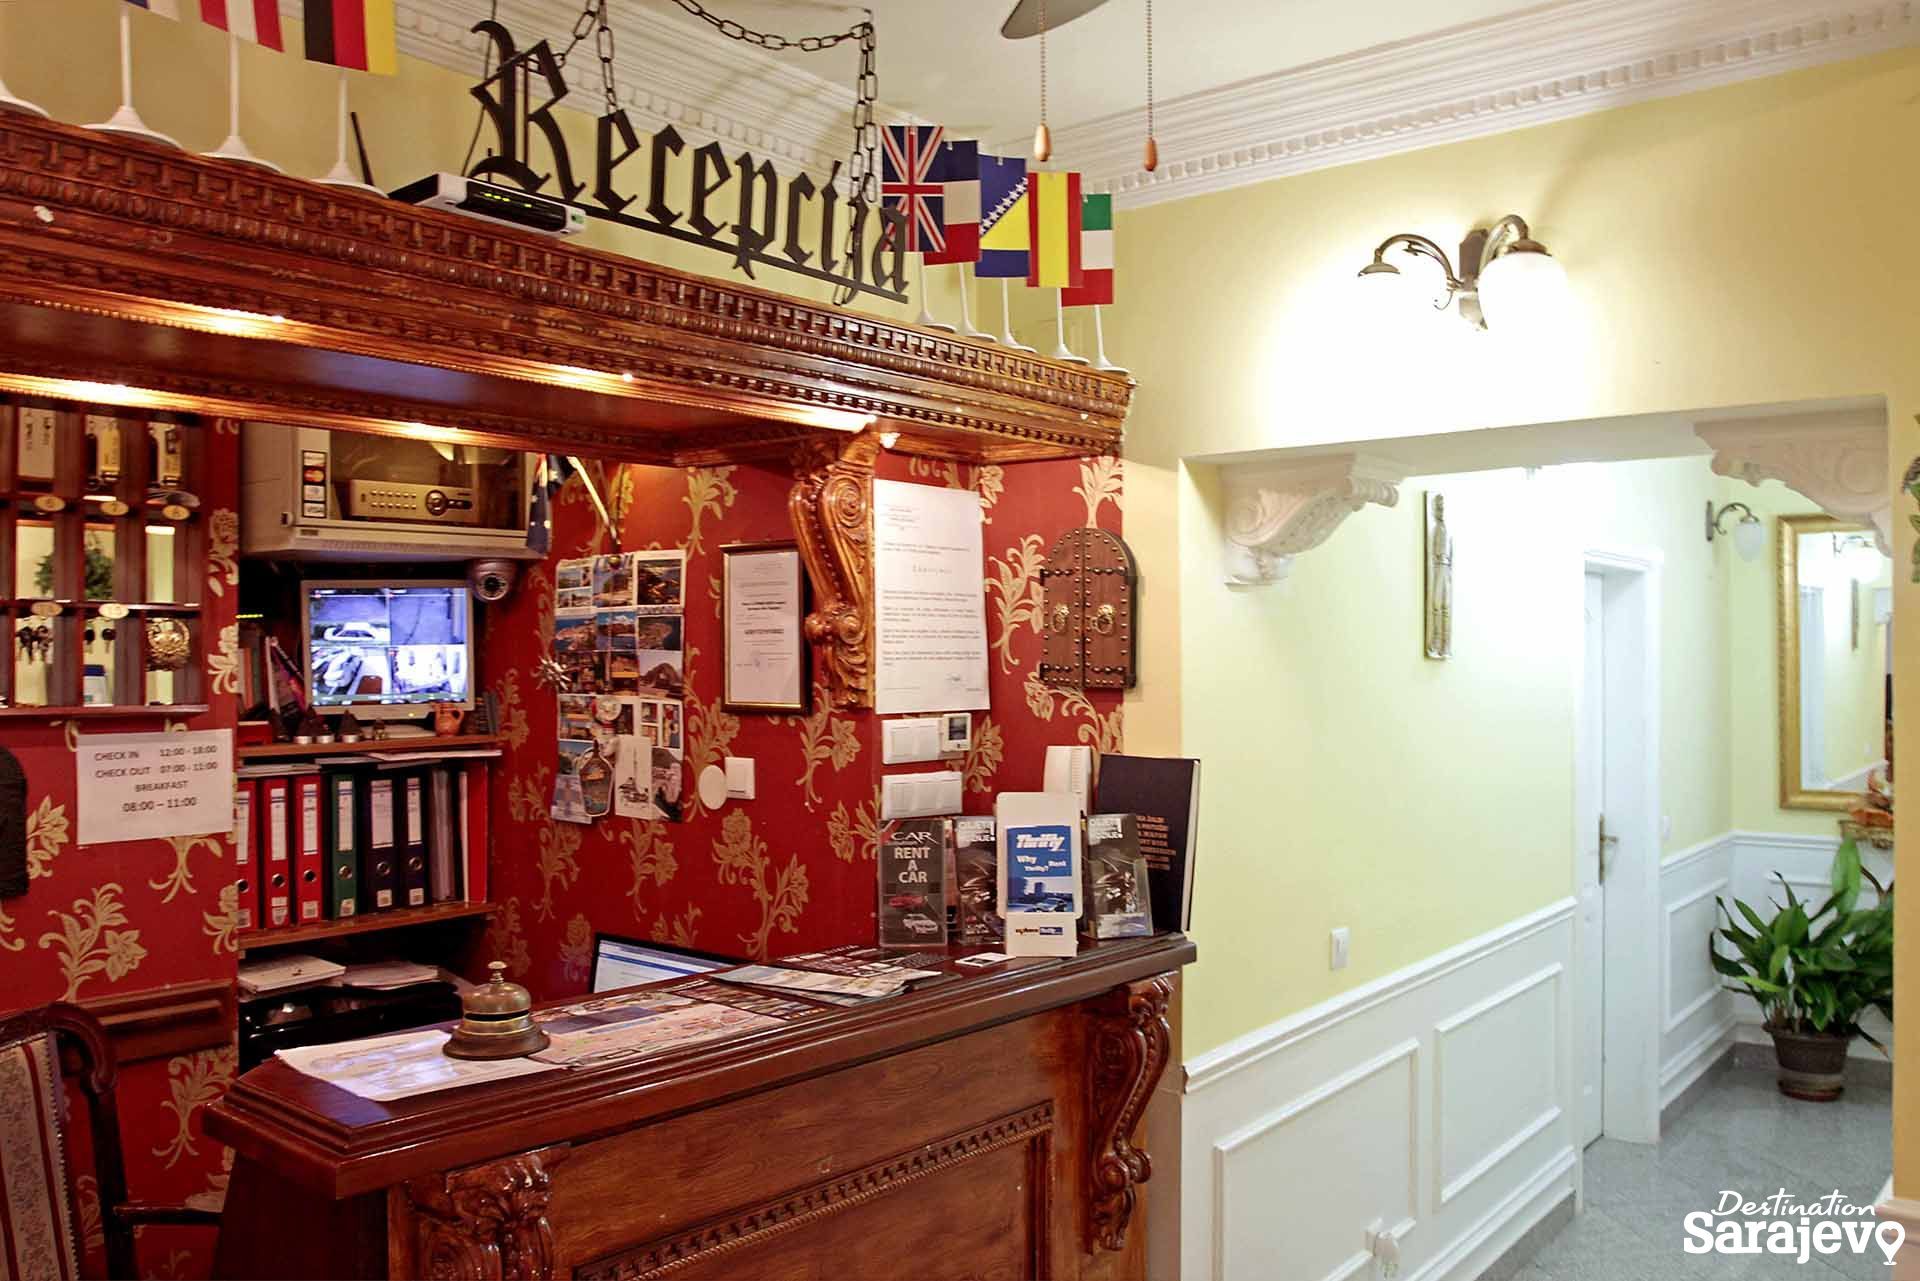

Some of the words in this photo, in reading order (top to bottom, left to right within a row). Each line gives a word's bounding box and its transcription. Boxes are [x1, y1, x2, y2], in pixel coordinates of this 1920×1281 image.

[467, 20, 909, 304] Recepcija
[94, 753, 126, 761] CHECK
[128, 751, 140, 759] IN
[160, 748, 184, 757] 12:00
[95, 769, 127, 777] CHECK
[129, 766, 152, 776] OUT
[135, 780, 188, 792] BREAKFAST
[122, 801, 155, 812] 08:00
[167, 797, 197, 808] 11:00
[890, 831, 940, 844] CAR
[894, 847, 931, 859] RENT
[907, 860, 918, 871] A
[1016, 855, 1037, 864] Why
[898, 871, 928, 883] CAR
